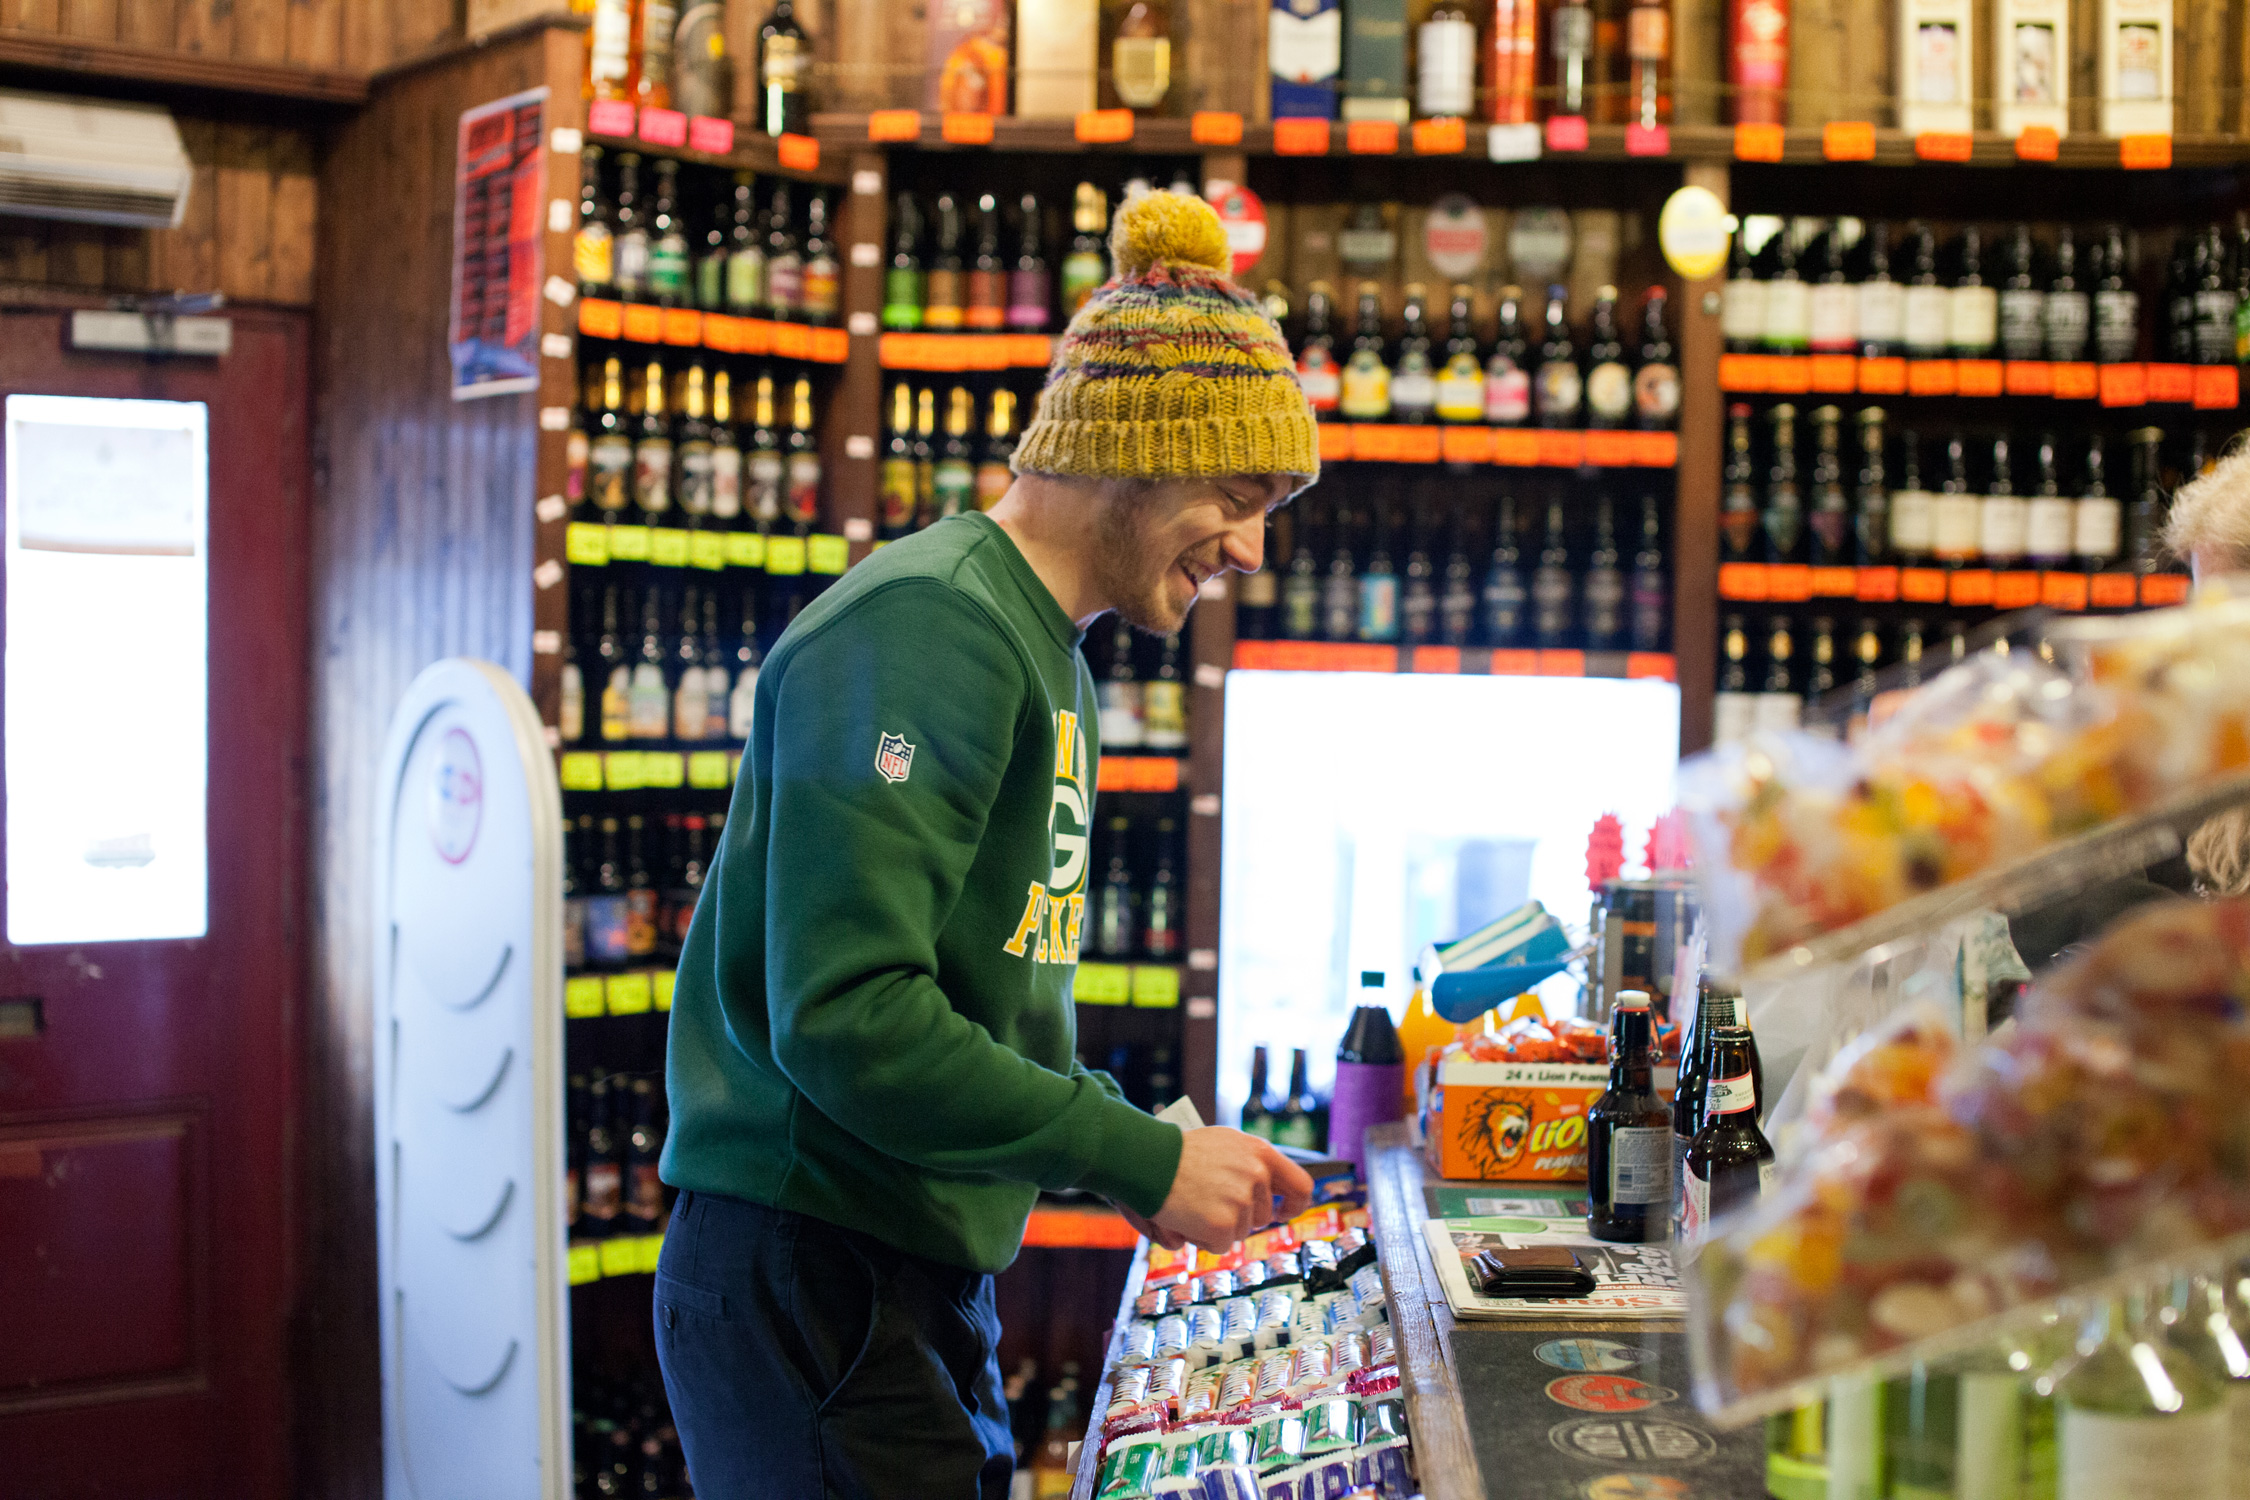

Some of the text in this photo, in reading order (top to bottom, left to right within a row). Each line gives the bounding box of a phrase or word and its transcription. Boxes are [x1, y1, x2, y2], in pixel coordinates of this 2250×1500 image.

[882, 752, 905, 777] NFL
[1505, 1070, 1521, 1080] 24
[1526, 1072, 1533, 1080] x
[1538, 1070, 1566, 1080] Lion
